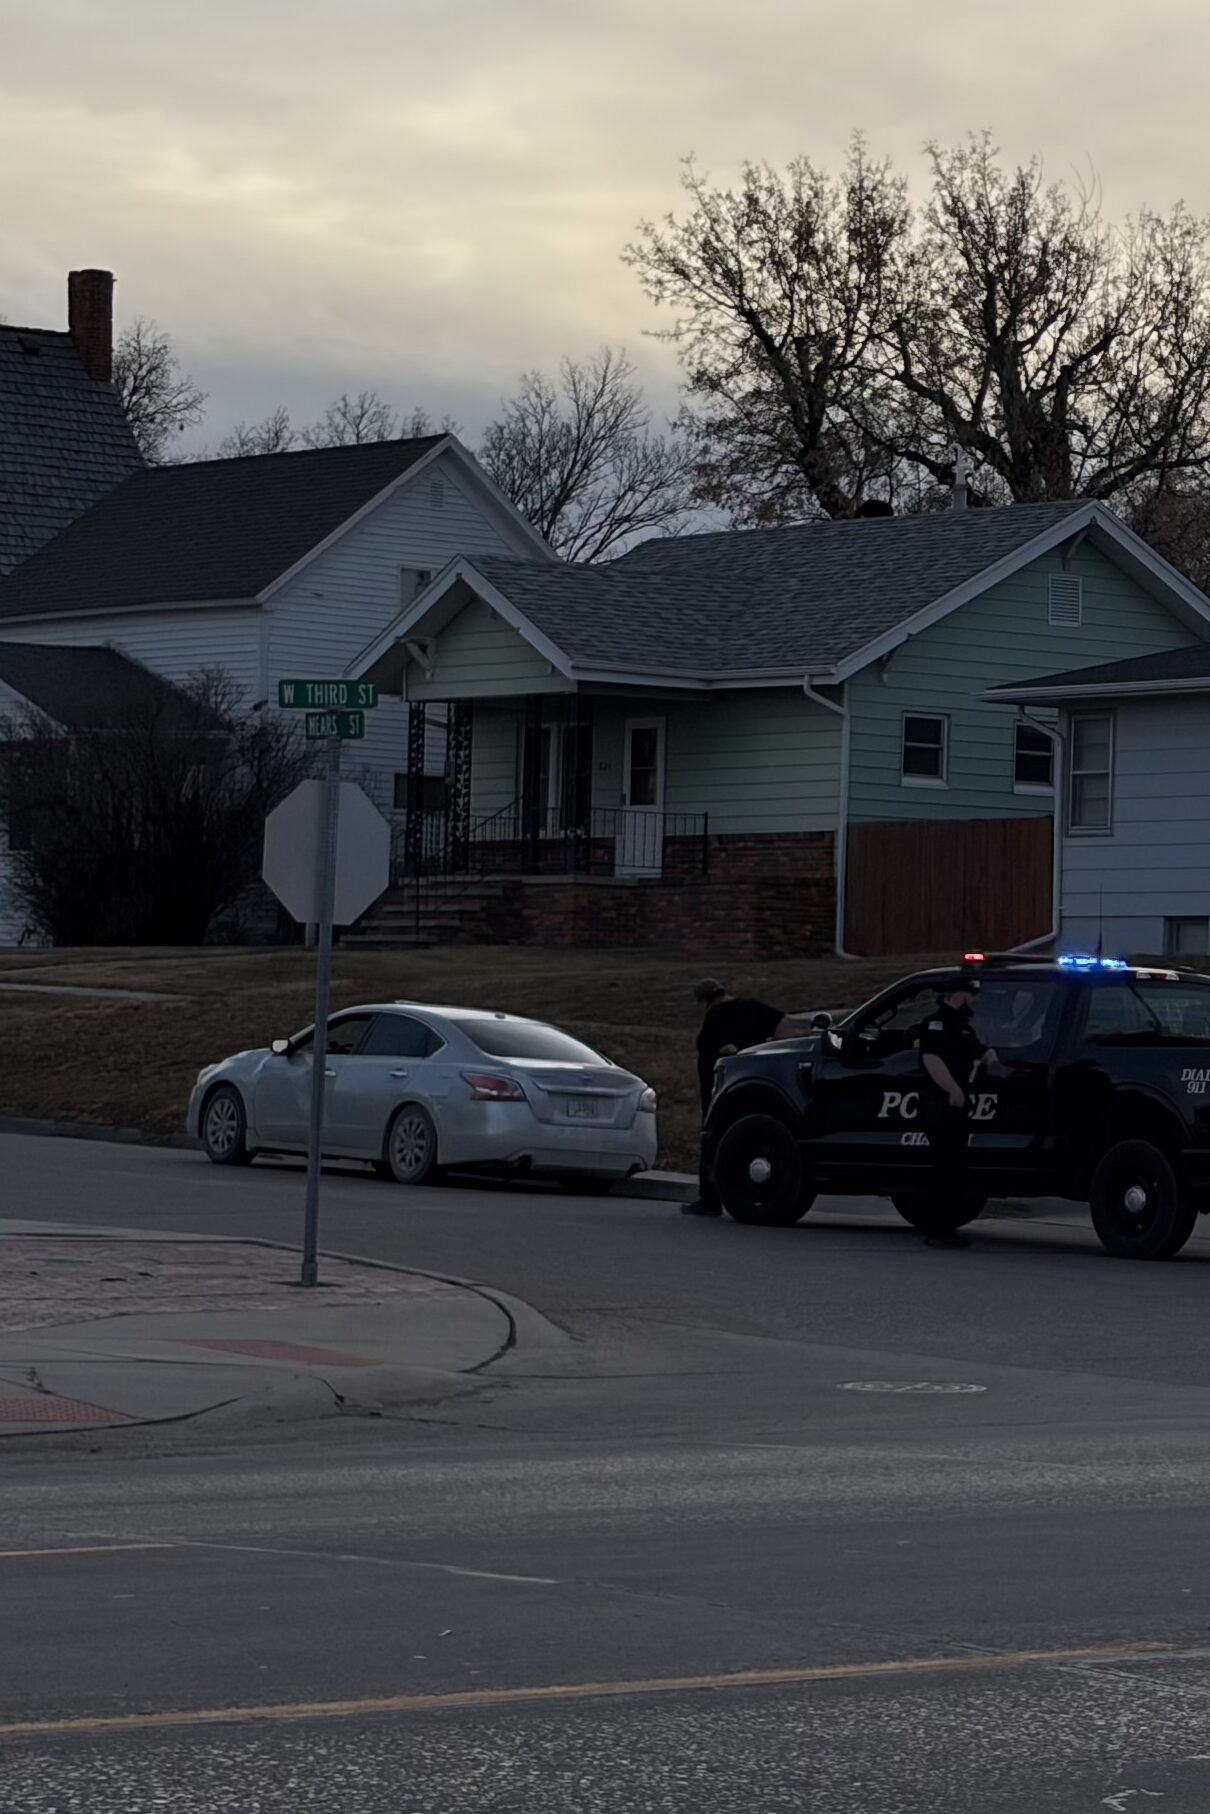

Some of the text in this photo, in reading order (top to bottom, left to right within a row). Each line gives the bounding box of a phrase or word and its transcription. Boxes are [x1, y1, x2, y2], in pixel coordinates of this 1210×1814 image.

[282, 683, 376, 705] W THIRD ST
[348, 713, 361, 736] ST
[1186, 1081, 1207, 1094] 911
